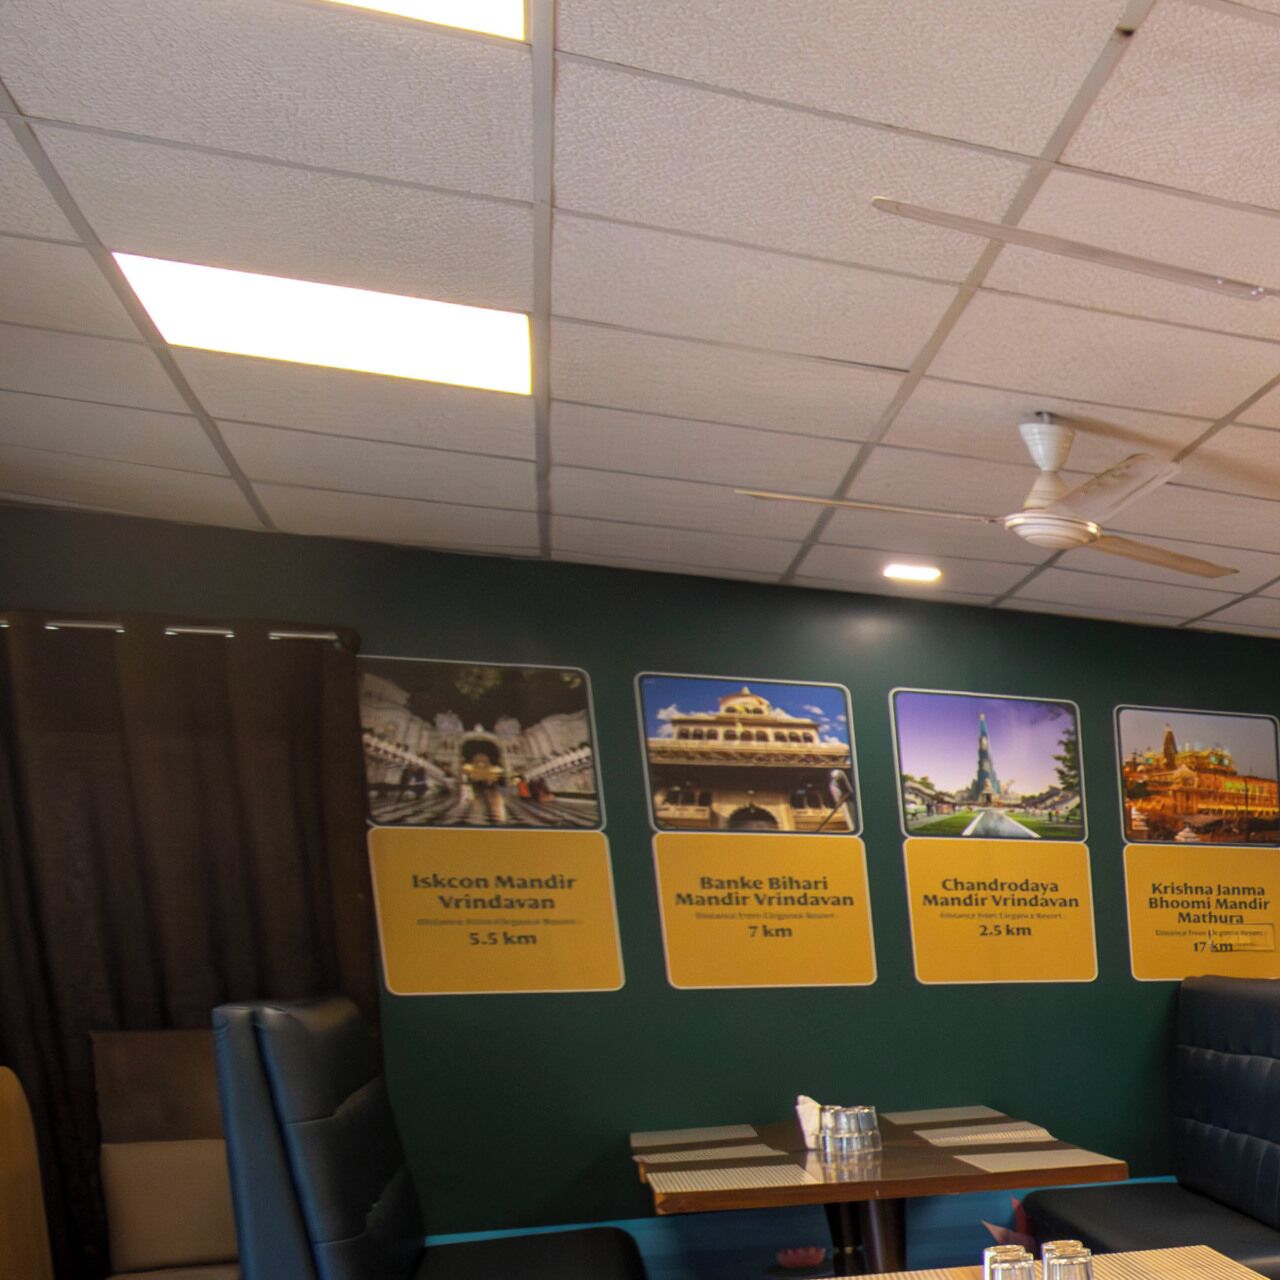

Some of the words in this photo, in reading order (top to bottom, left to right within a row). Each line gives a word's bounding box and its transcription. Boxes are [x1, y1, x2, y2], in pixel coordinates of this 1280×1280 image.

[412, 874, 490, 889] Iskcon
[495, 875, 576, 890] Mandir
[700, 876, 764, 890] Banke
[768, 876, 829, 891] Bihari
[942, 878, 1060, 895] Chandrodaya
[1151, 882, 1214, 896] Krishna
[1217, 884, 1266, 897] Janma
[438, 894, 556, 910] Vrindavan
[675, 892, 751, 907] Mandir
[754, 893, 855, 907] Vrindavan
[923, 894, 988, 908] Mandir
[992, 894, 1080, 908] Vrindavan
[1149, 897, 1212, 910] Bhoomi
[1215, 898, 1271, 911] Mandir
[1177, 911, 1245, 925] Mathura
[748, 924, 759, 938] 7
[763, 924, 793, 938] km
[979, 925, 1002, 936] 2.5
[1006, 924, 1032, 936] km
[469, 932, 499, 946] 5.5
[503, 931, 538, 945] km
[1193, 941, 1206, 952] 17
[1211, 940, 1234, 953] km
